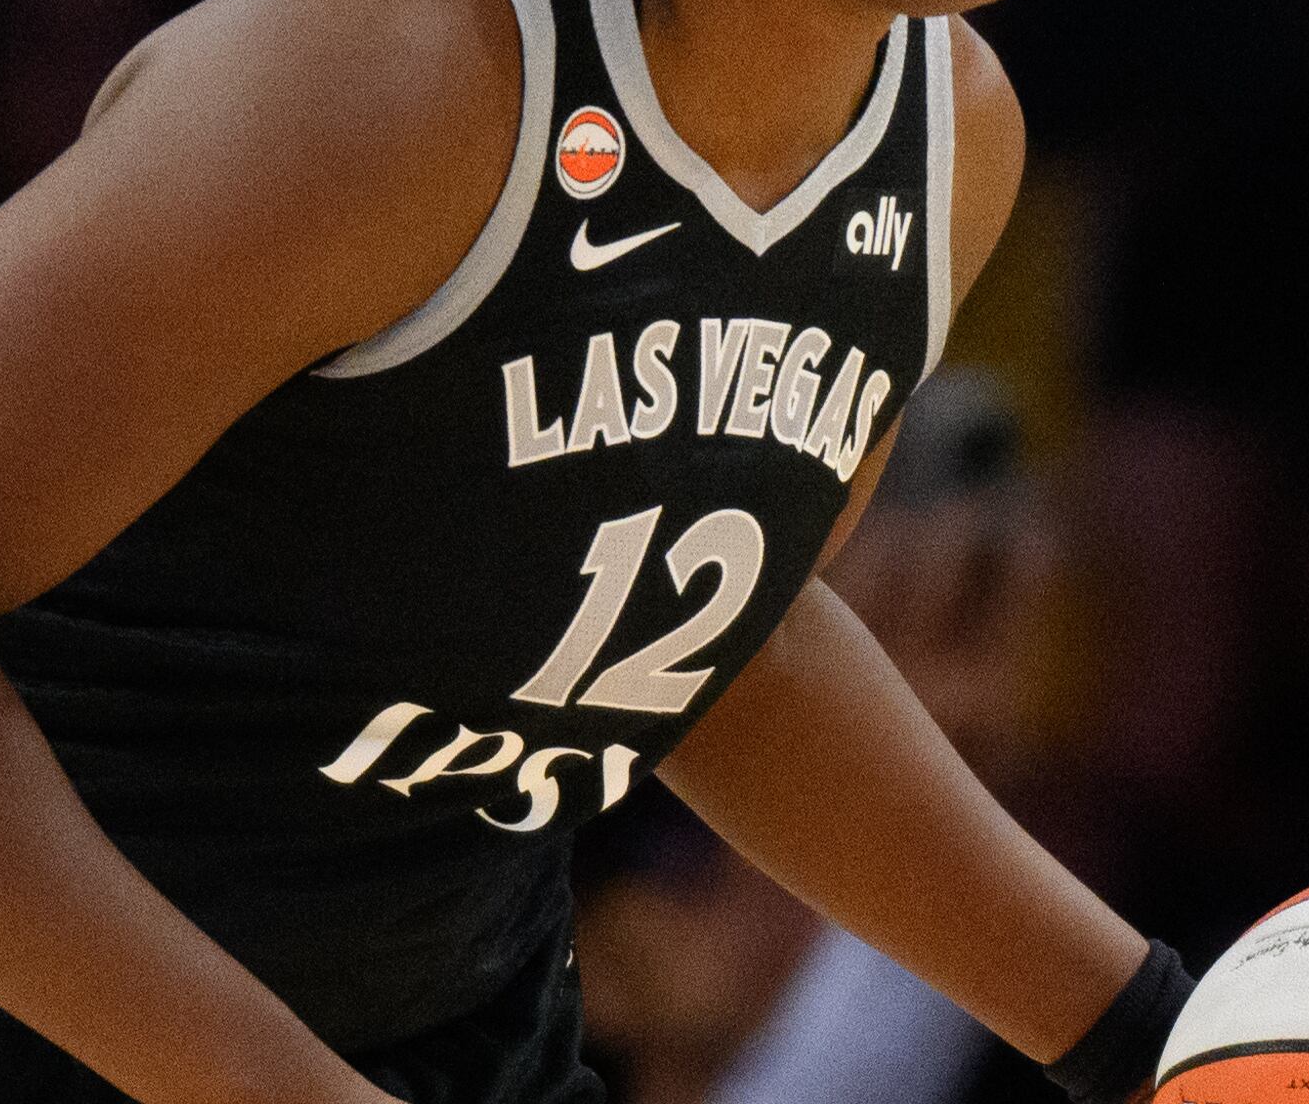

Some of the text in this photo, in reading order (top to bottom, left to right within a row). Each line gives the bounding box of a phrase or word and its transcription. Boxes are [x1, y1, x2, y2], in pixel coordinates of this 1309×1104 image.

[846, 196, 912, 271] ally
[502, 317, 891, 483] LAS VEGAS
[509, 505, 765, 714] 12
